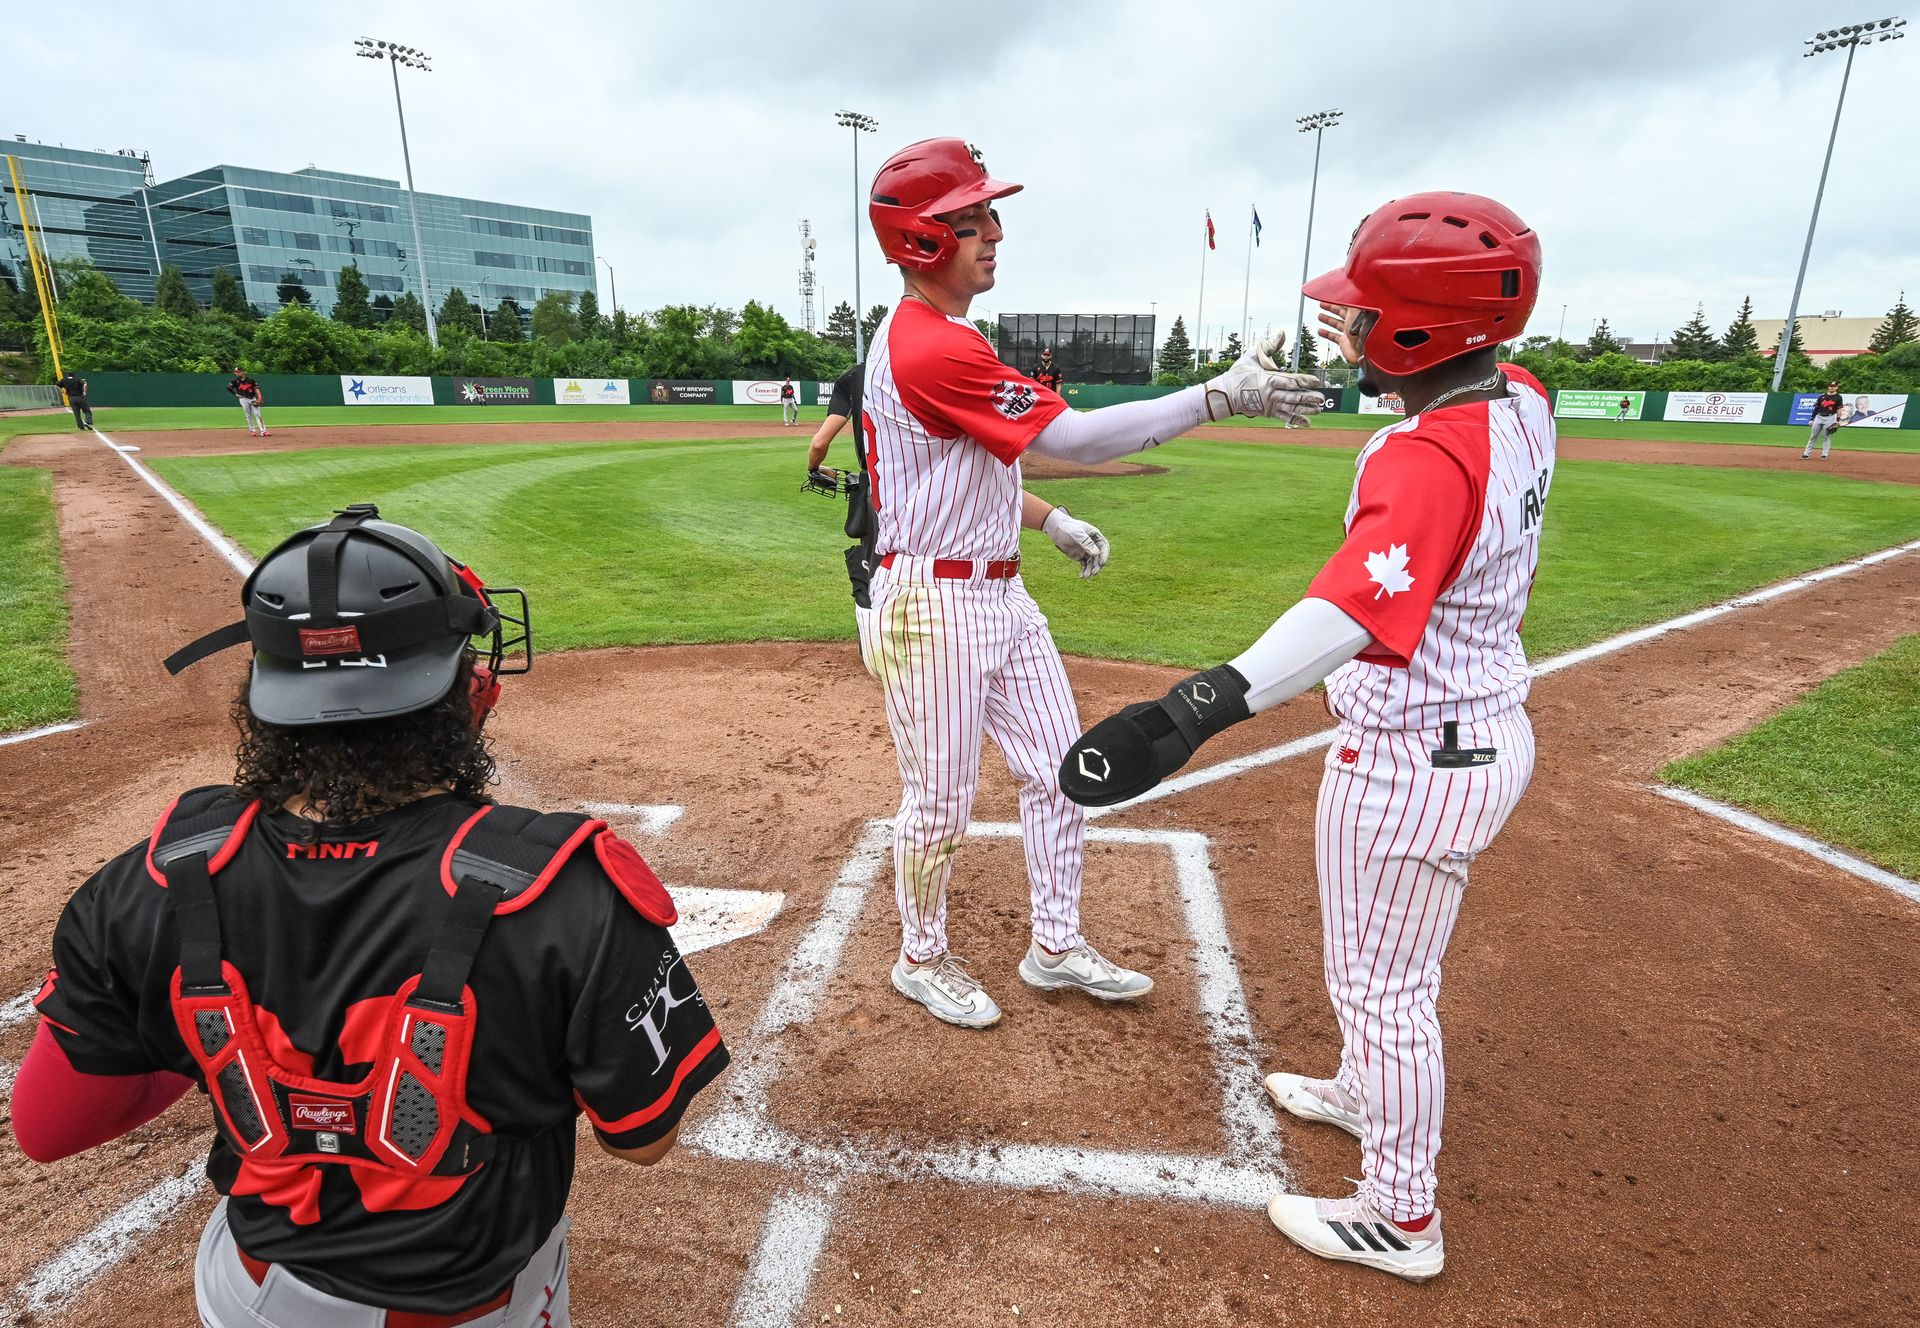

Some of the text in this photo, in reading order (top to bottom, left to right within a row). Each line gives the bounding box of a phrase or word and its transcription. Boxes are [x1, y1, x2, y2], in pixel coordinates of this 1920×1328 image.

[1465, 333, 1487, 345] S100
[367, 384, 407, 394] orleans
[504, 385, 529, 393] Works
[369, 393, 431, 403] orthodontics
[1683, 405, 1745, 415] CABLES PLUS
[1873, 415, 1898, 424] move
[1177, 688, 1203, 720] EVOSHIELD
[286, 840, 380, 859] MNM
[296, 1106, 348, 1124] Rawlings
